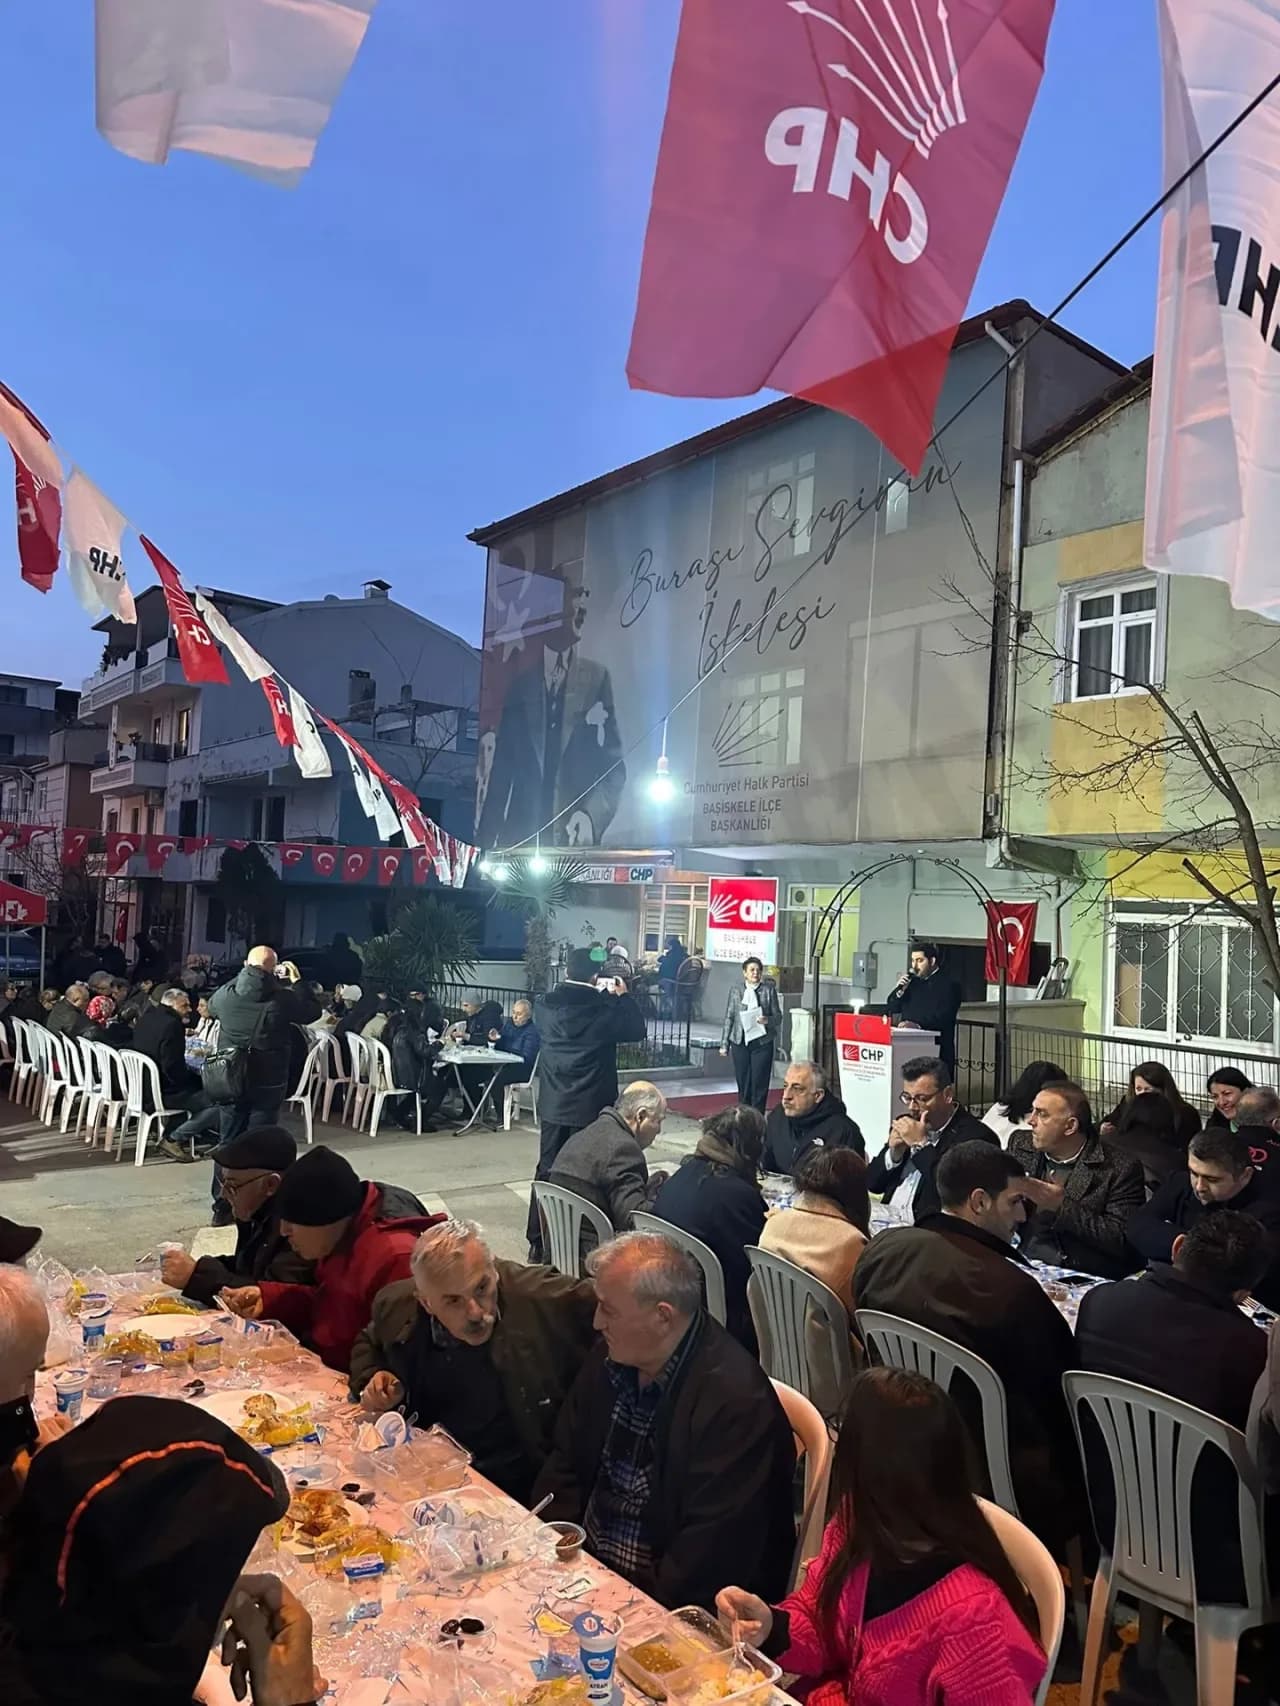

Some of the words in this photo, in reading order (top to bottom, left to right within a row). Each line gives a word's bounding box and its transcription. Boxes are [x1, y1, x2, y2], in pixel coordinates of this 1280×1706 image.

[620, 545, 746, 628] Burası
[743, 776, 769, 791] Halk
[771, 773, 810, 788] Partisi
[759, 797, 782, 814] İLÇE
[710, 816, 771, 834] BAŞKANLIĞI
[630, 867, 653, 881] CHP
[740, 898, 775, 924] CHP
[860, 1048, 884, 1062] CHP
